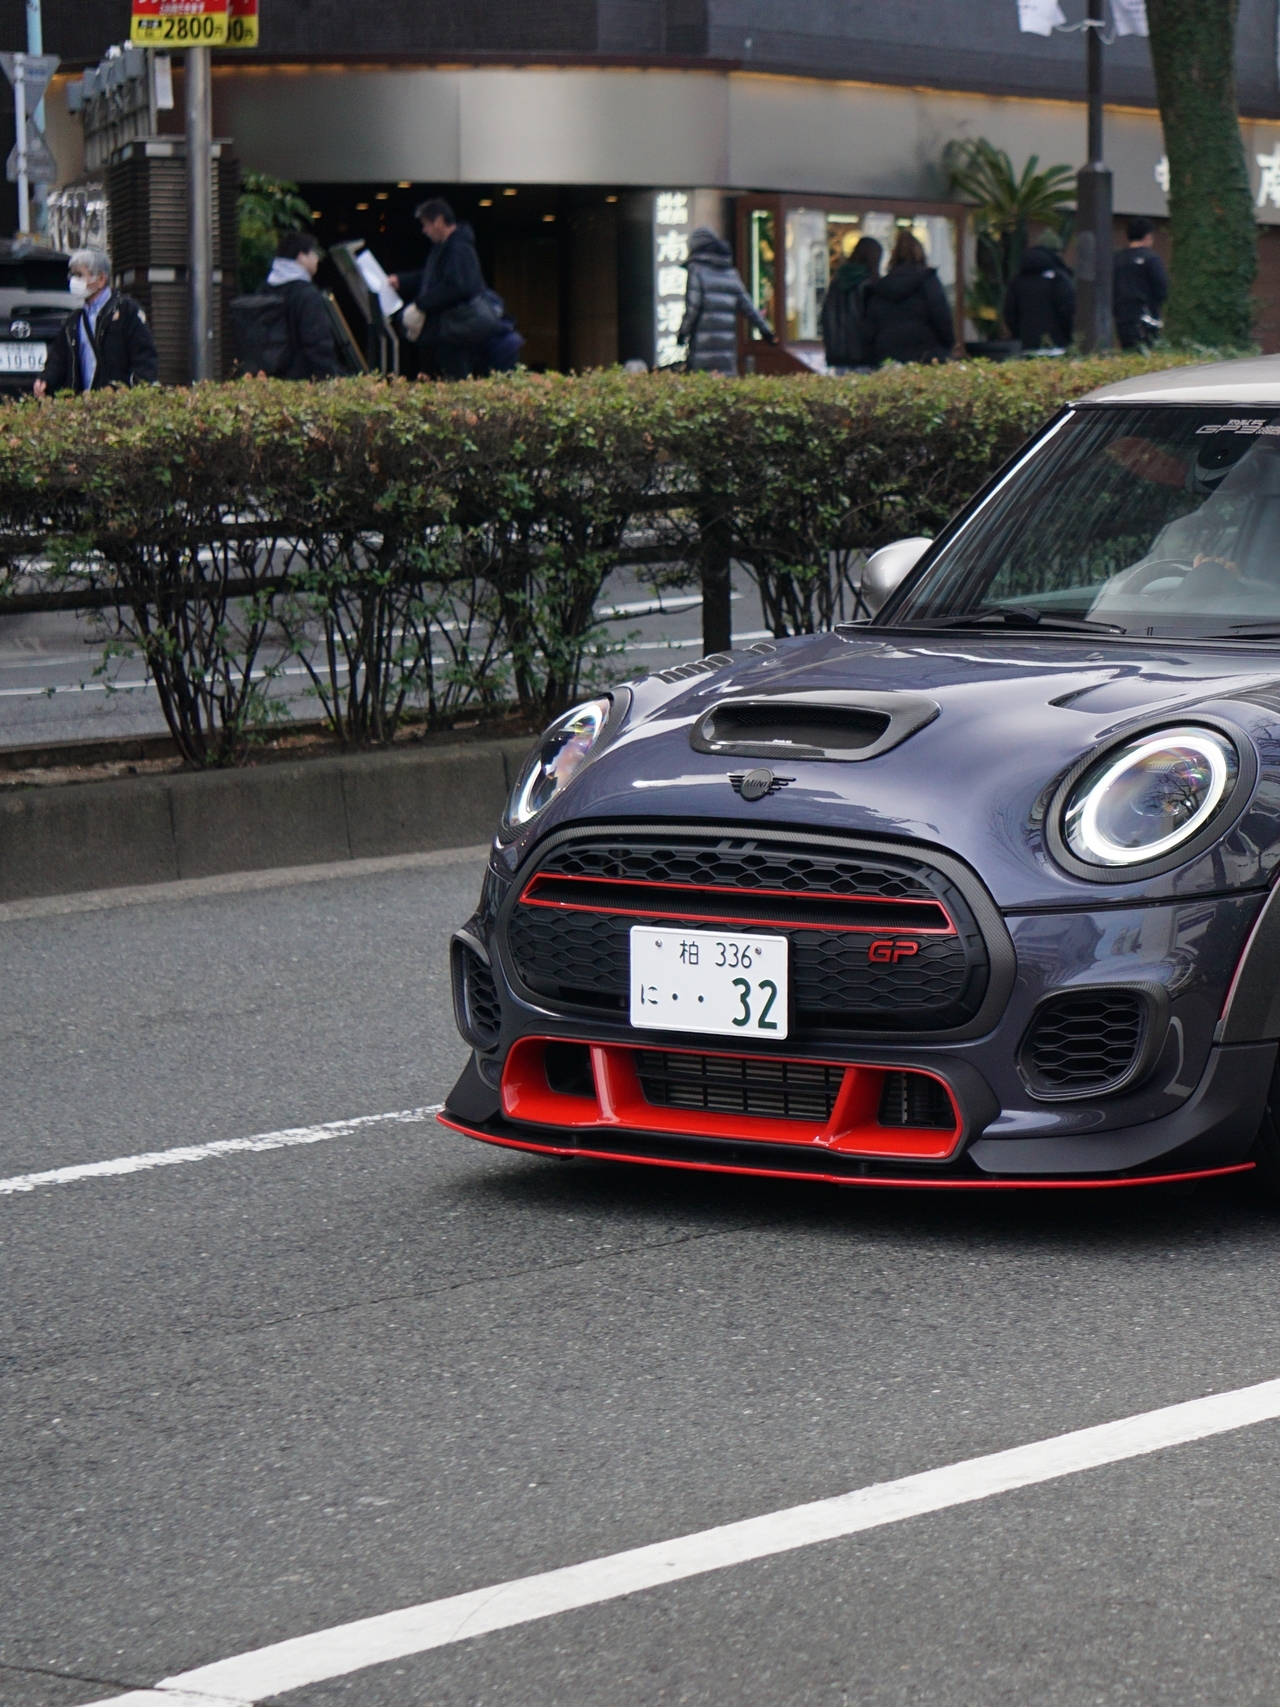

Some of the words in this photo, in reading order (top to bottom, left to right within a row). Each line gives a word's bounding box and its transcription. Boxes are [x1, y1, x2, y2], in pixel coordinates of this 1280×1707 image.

[744, 779, 768, 788] MINI
[679, 939, 699, 966] 柏
[714, 942, 753, 969] 336
[868, 940, 919, 964] GP
[640, 983, 659, 1005] に
[731, 977, 778, 1030] 32
